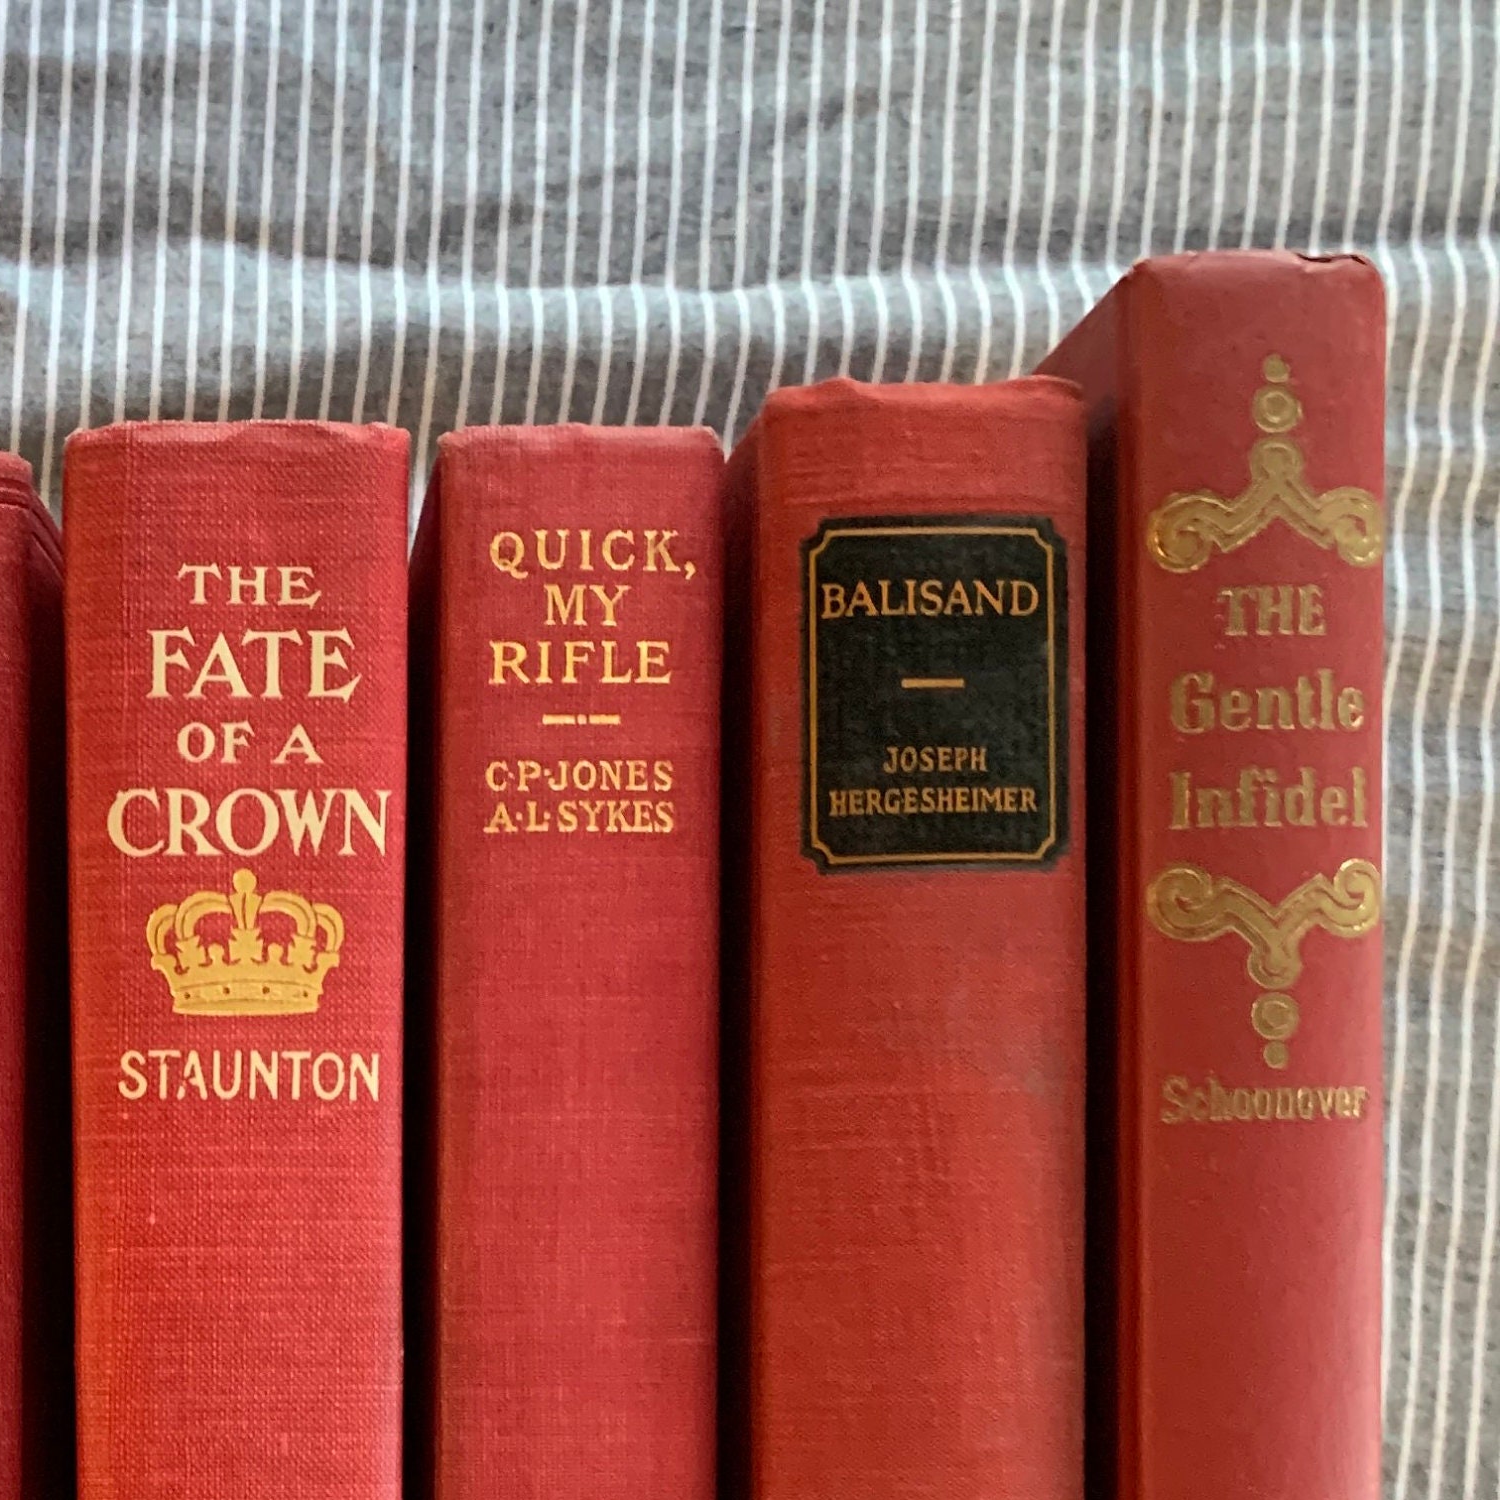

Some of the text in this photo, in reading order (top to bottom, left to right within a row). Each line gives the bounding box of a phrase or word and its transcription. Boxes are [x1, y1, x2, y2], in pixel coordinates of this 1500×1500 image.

[489, 530, 696, 580] QUICK,
[177, 562, 322, 608] THE
[543, 585, 631, 626] MY
[821, 580, 1039, 619] BALISAND
[1216, 585, 1326, 637] THE
[146, 627, 362, 703] FATE
[489, 640, 672, 685] RIFLE
[1169, 670, 1365, 734] Gentle
[177, 721, 322, 765] OF A
[882, 746, 987, 775] JOSEPH
[108, 787, 392, 857] CROWN
[828, 787, 1037, 817] HERGESHEIMER
[1168, 767, 1368, 830] Infidel
[118, 1050, 380, 1101] STAUNTON
[1161, 1073, 1367, 1123] Schoonover
